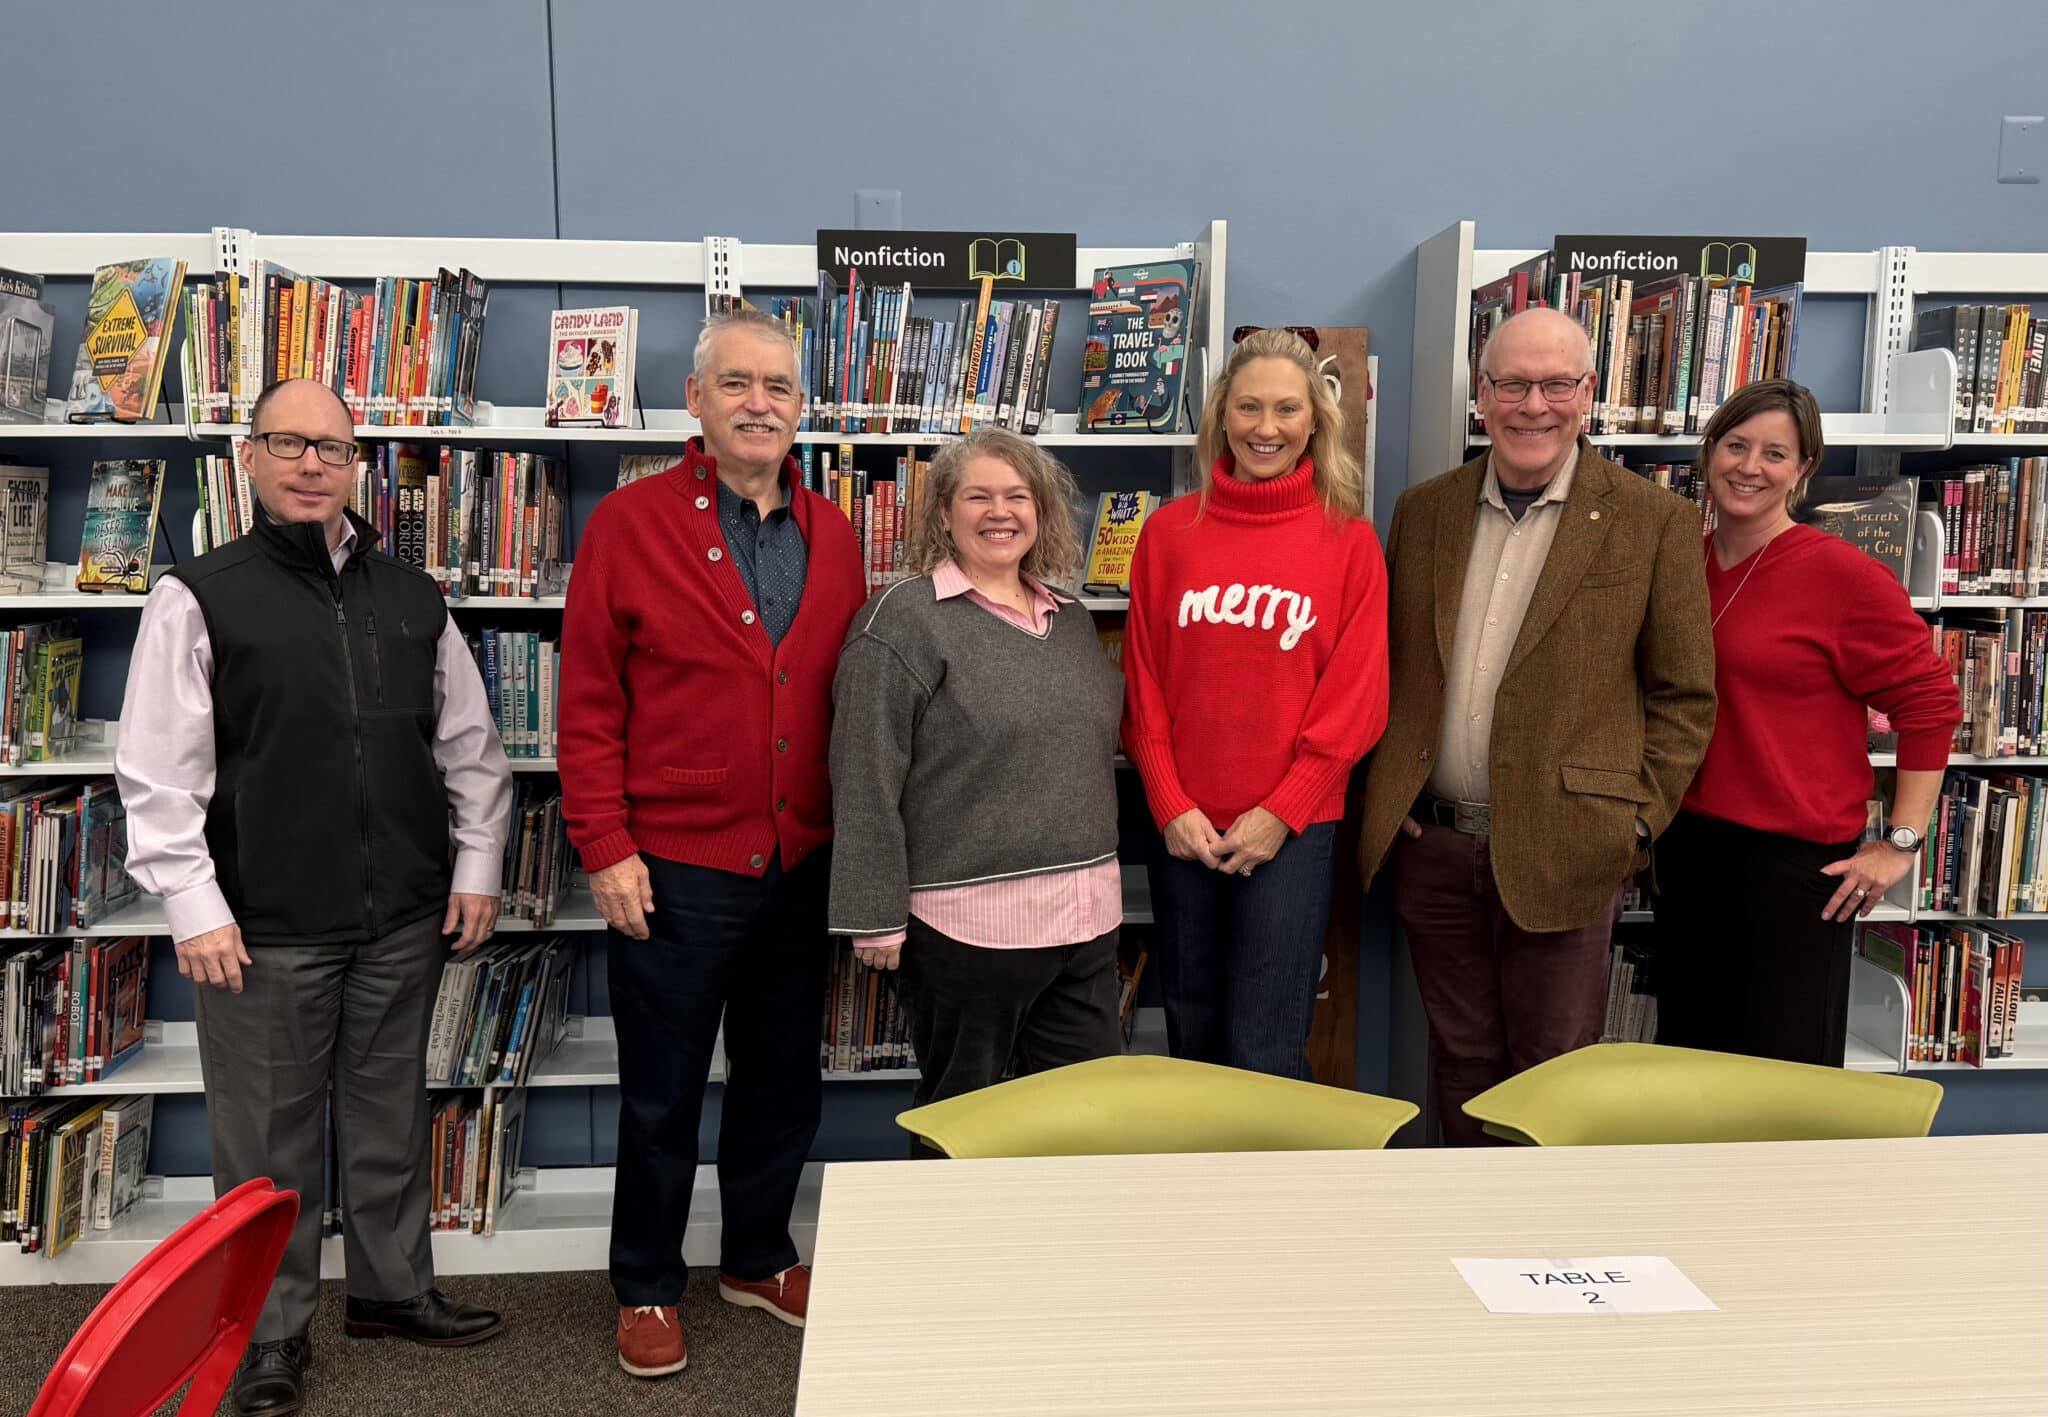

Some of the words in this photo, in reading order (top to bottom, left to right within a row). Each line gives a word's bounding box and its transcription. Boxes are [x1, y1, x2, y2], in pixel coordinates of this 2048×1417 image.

[834, 246, 945, 267] Nonfiction
[1570, 250, 1678, 270] Nonfiction
[103, 316, 137, 333] EXTREME
[555, 313, 591, 329] CANDY
[594, 312, 624, 327] LAND
[1127, 317, 1144, 330] THE
[94, 334, 136, 355] SURVIVAL
[1113, 332, 1154, 349] TRAVEL
[348, 328, 359, 376] Generation
[970, 334, 983, 388] EXPLORAPEDIA
[1115, 351, 1148, 369] BOOK
[2030, 333, 2045, 373] DIVE!
[1022, 353, 1032, 391] CAPSIZED!
[8, 480, 40, 503] EXTRA
[106, 483, 128, 497] MAKE
[119, 498, 139, 512] ALIVE
[853, 498, 863, 529] BONNIE
[1110, 507, 1136, 519] WHAT?
[14, 505, 32, 527] LIFE
[1852, 508, 1900, 522] Secrets
[95, 519, 123, 539] DESERT
[1097, 527, 1113, 545] 50
[1112, 535, 1135, 544] KIDS
[1857, 526, 1869, 537] of
[1874, 526, 1890, 537] the
[101, 532, 131, 553] ISLAND
[1102, 547, 1134, 556] AMAZING
[1875, 540, 1903, 557] City
[1098, 563, 1125, 575] STORIES
[1178, 583, 1317, 651] merry
[503, 716, 512, 728] FLY
[516, 716, 525, 728] FLY
[70, 991, 80, 1027] ROBOT
[840, 983, 854, 1027] AMERICAN
[1992, 982, 2005, 1026] FALLOUT
[2008, 979, 2020, 1024] FALLOUT
[101, 1121, 114, 1172] BUZZKILL
[1520, 1271, 1631, 1286] TABLE
[1582, 1291, 1606, 1304] 2
